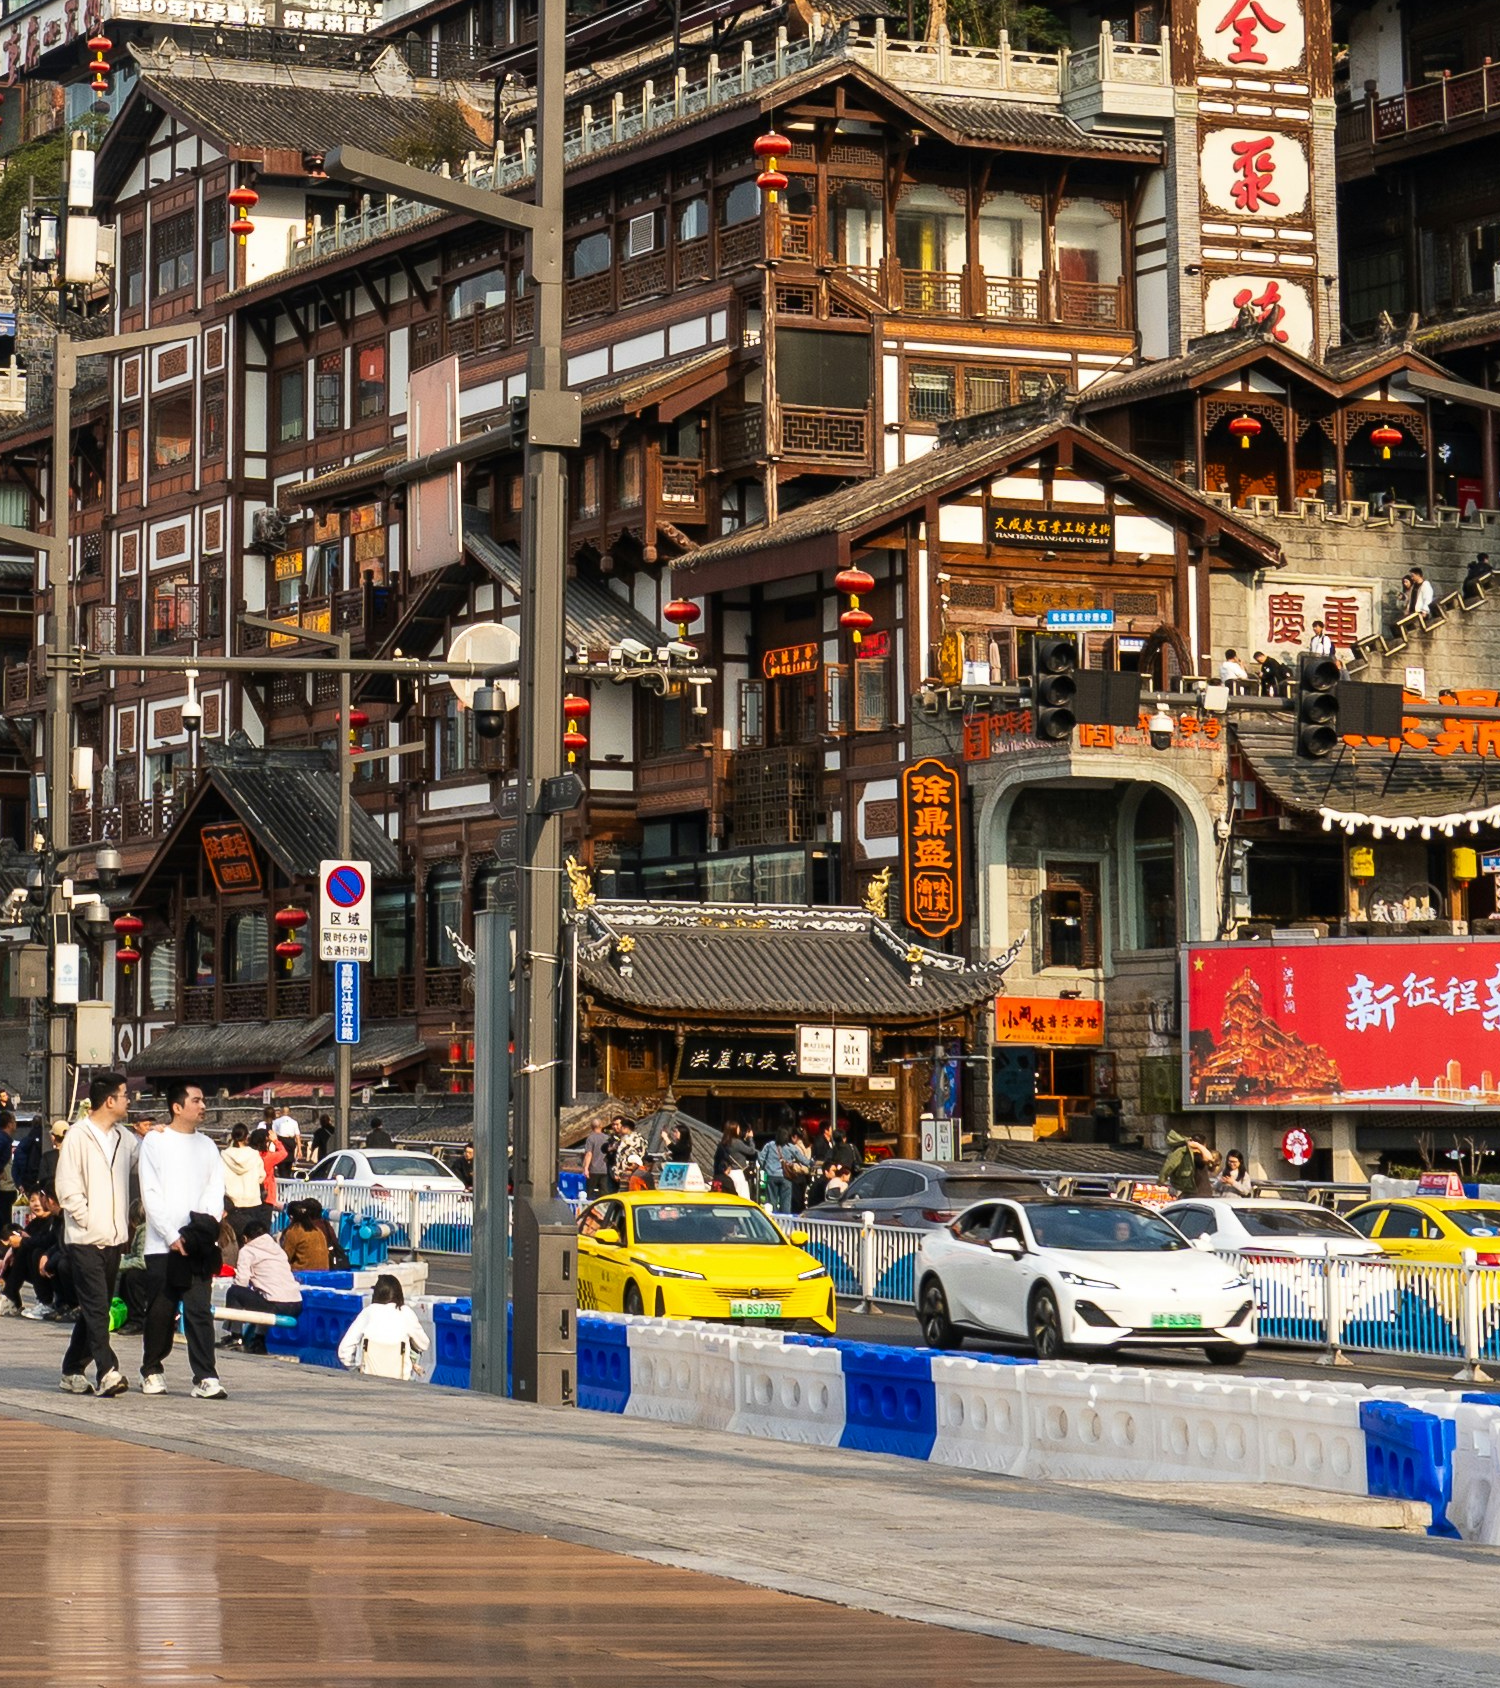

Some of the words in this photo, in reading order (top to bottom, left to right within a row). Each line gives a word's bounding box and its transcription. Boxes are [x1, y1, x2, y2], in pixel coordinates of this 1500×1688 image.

[911, 775, 953, 869] 徐鼎盛
[331, 912, 361, 926] 区域
[323, 932, 368, 943] 限时6分钟
[690, 1049, 797, 1072] 洪崖洞夜市
[843, 1057, 861, 1066] 入口
